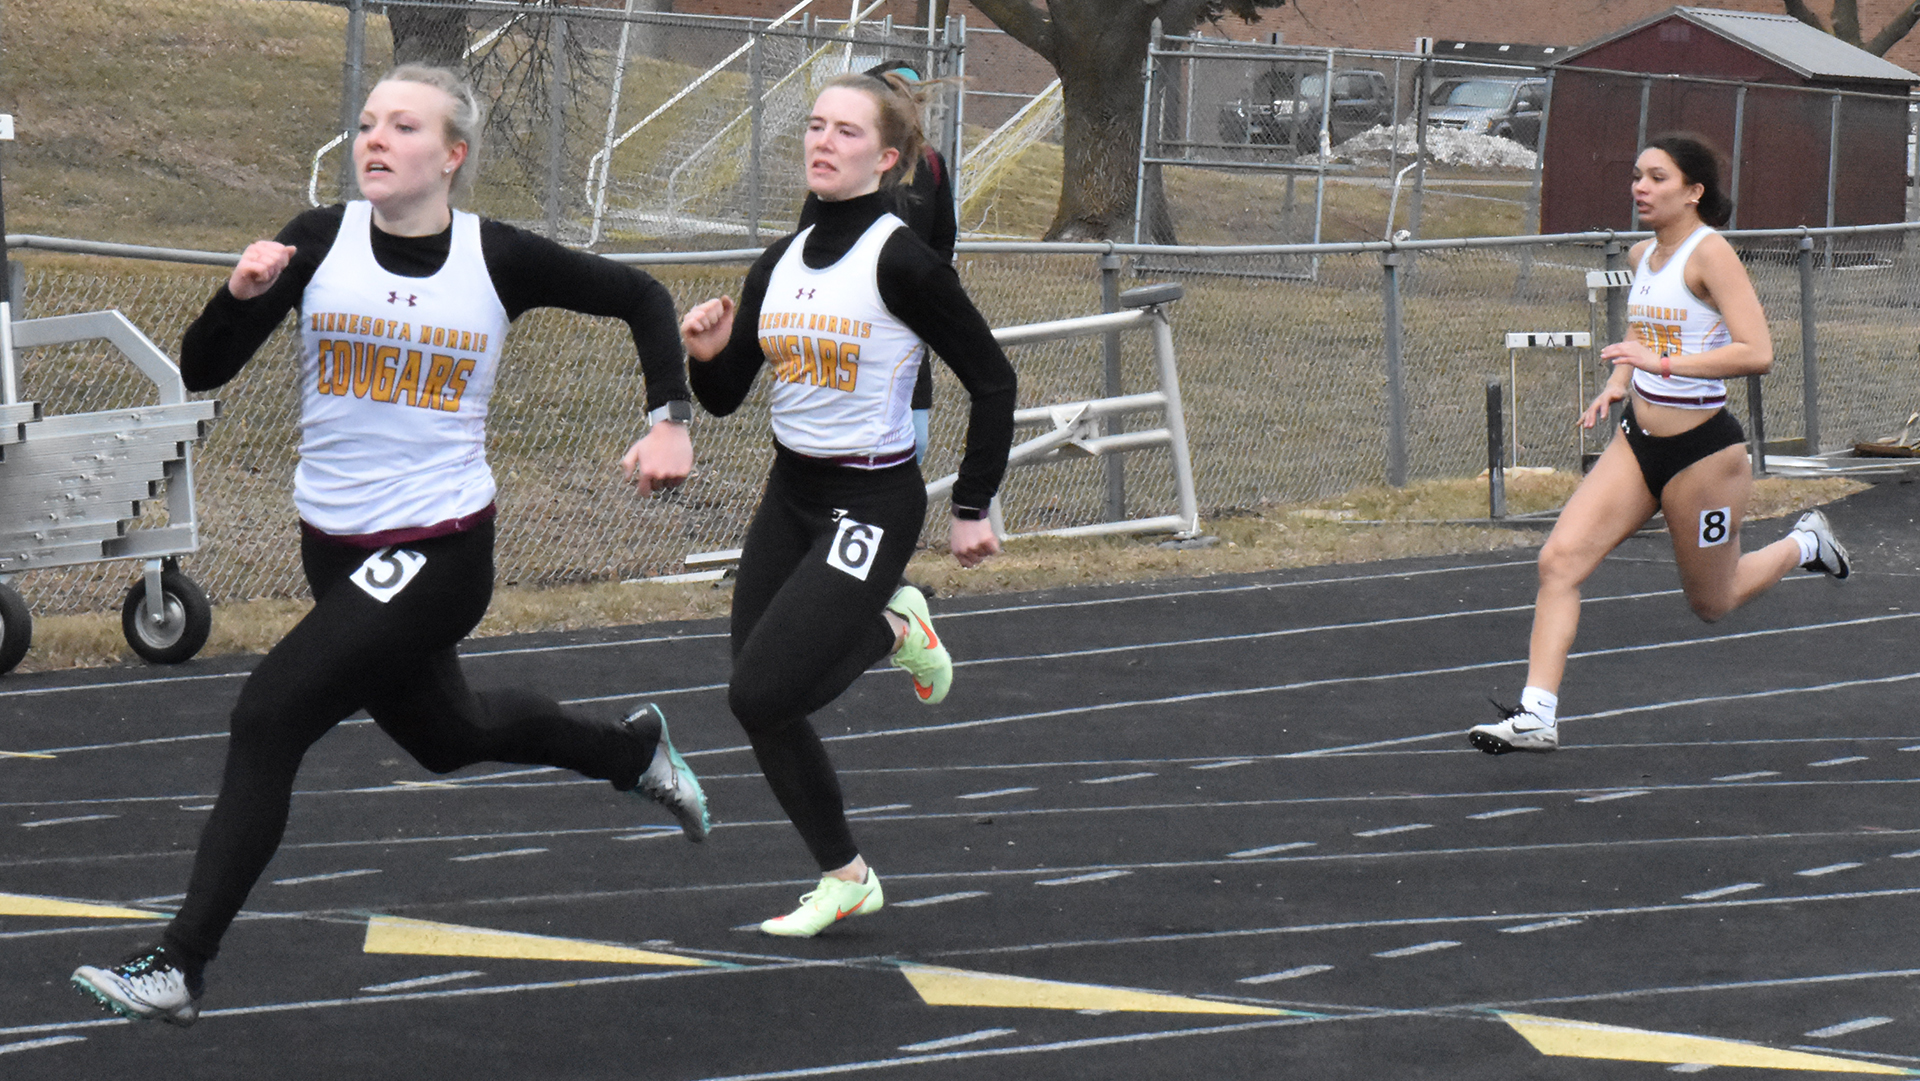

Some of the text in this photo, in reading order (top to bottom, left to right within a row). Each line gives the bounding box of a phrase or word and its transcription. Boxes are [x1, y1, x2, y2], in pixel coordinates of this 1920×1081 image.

[311, 312, 488, 353] MINNESOTA MORRIS
[809, 313, 872, 339] MORRIS
[318, 339, 476, 412] COUGARS
[838, 524, 874, 569] 6
[1703, 511, 1726, 543] 8
[365, 546, 420, 590] 5
